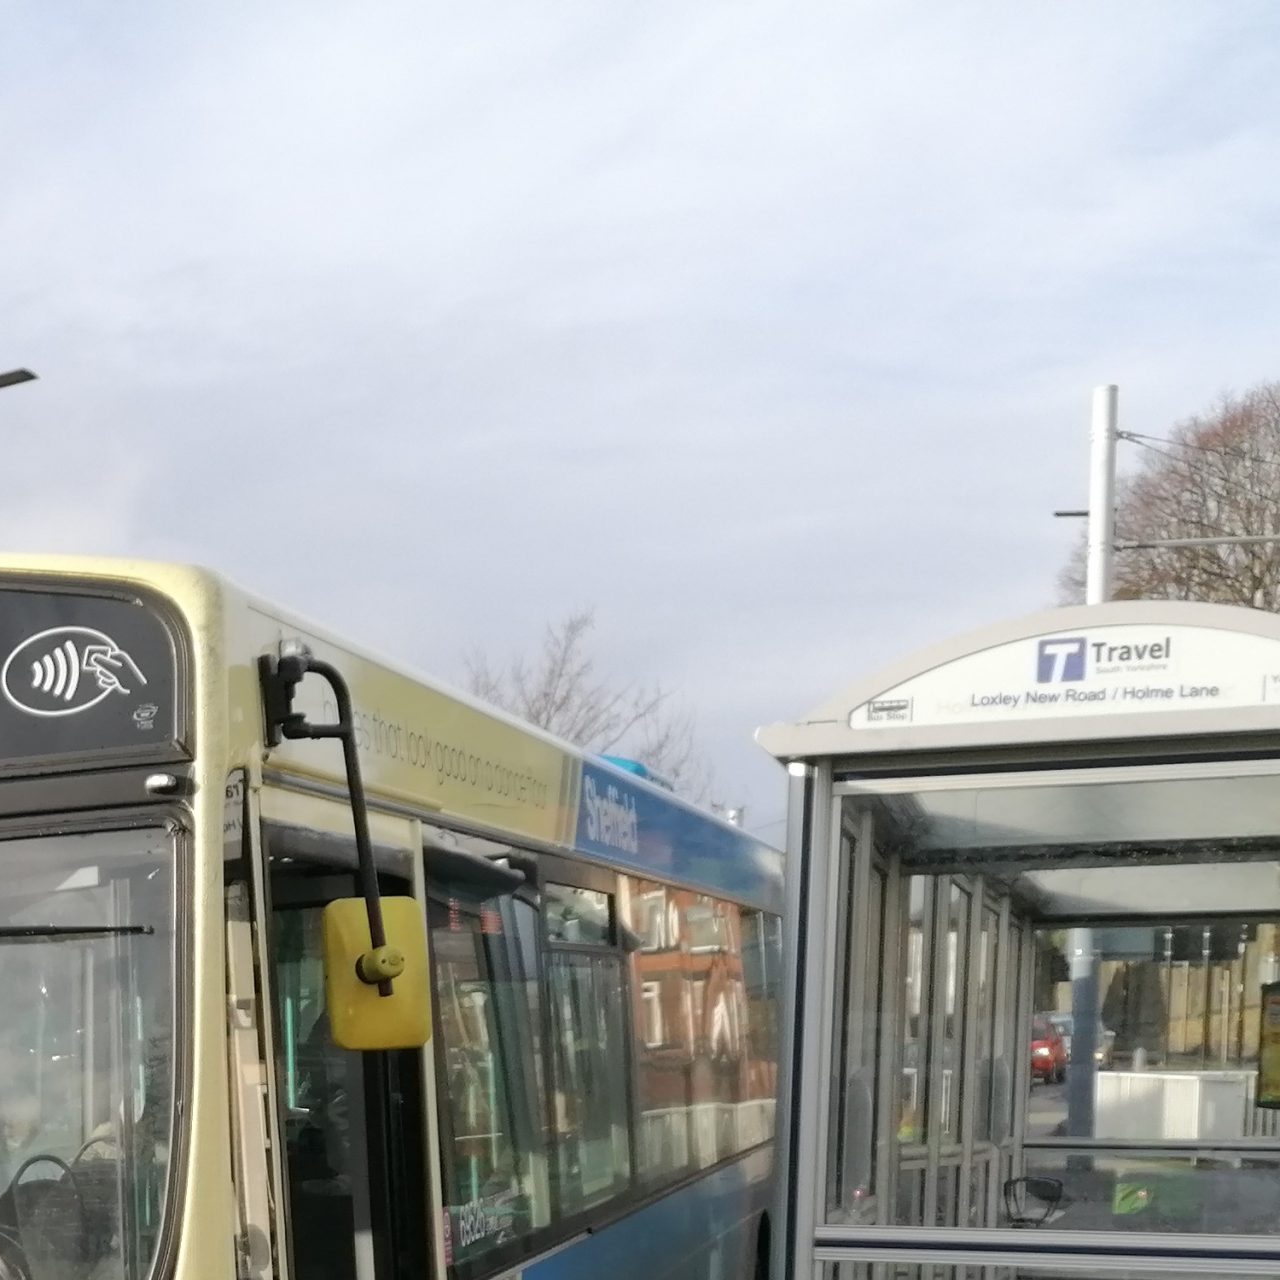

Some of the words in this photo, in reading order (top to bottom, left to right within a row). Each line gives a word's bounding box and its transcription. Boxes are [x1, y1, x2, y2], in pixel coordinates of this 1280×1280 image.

[1092, 637, 1171, 663] Travel
[971, 692, 1020, 707] Loxley
[1025, 691, 1060, 703] New
[1065, 688, 1106, 701] Road
[1123, 686, 1174, 700] Holme
[1179, 684, 1220, 698] Lane
